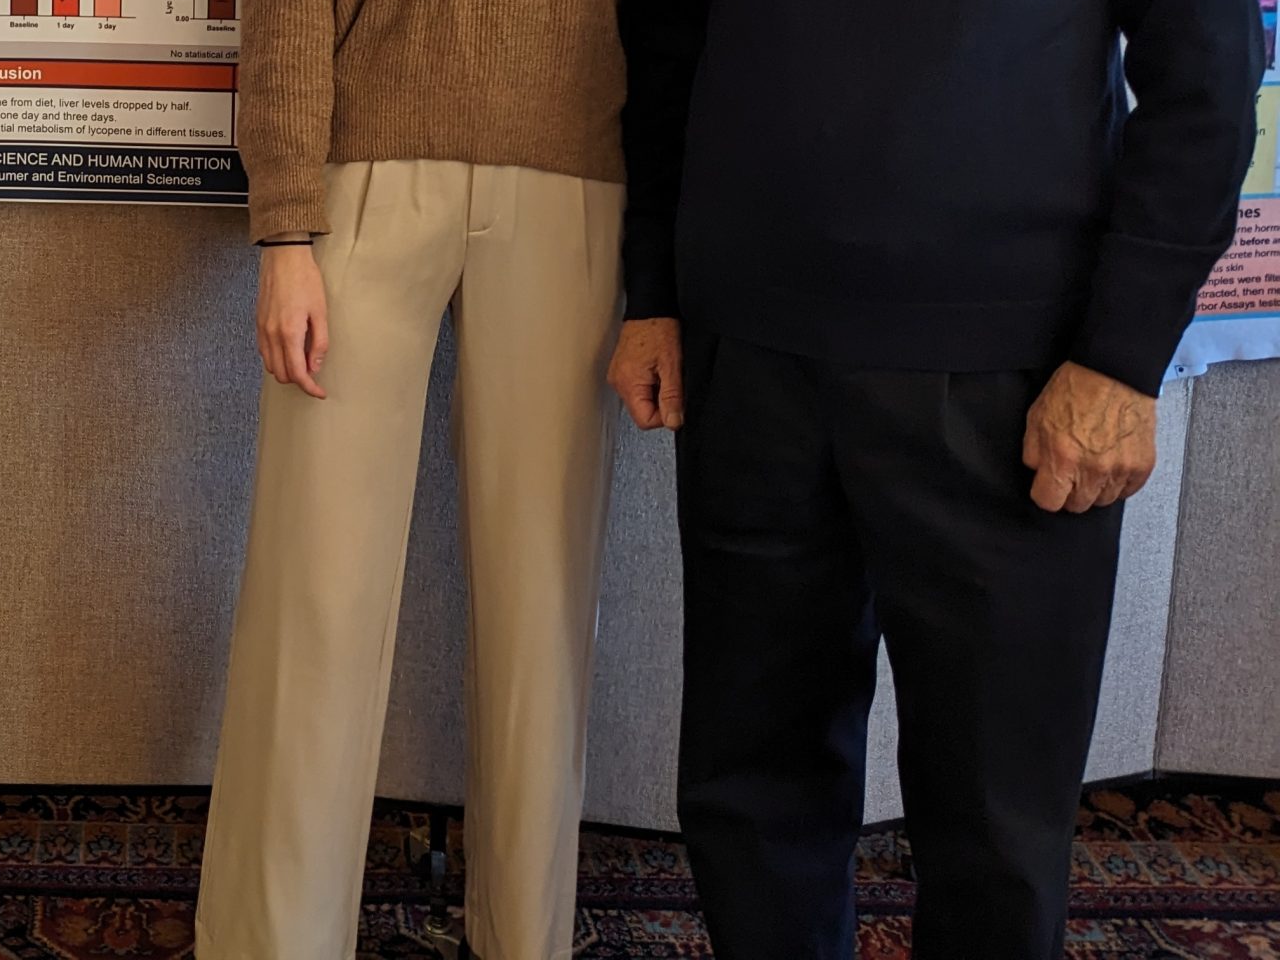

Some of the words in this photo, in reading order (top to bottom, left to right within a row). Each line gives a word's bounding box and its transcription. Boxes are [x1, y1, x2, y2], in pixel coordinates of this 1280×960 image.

[170, 50, 183, 58] No
[185, 50, 223, 59] statistical
[10, 97, 32, 107] from
[35, 98, 56, 108] diet,
[59, 98, 79, 108] liver
[82, 99, 110, 109] levels
[113, 100, 153, 112] dropped
[156, 101, 168, 112] by
[171, 101, 191, 111] half.
[0, 112, 18, 120] one
[21, 111, 39, 122] day
[42, 111, 60, 120] and
[63, 112, 88, 121] three
[91, 112, 116, 124] days.
[18, 124, 73, 134] metabolism
[76, 125, 86, 134] of
[88, 125, 132, 137] lycopene
[135, 127, 143, 135] in
[146, 127, 186, 137] different
[189, 128, 226, 138] tissues.
[51, 153, 83, 166] AND
[88, 155, 143, 168] HUMAN
[148, 156, 230, 170] NUTRITION
[32, 171, 54, 182] and
[58, 171, 143, 184] Environmental
[147, 173, 201, 185] Sciences
[1240, 237, 1270, 246] before
